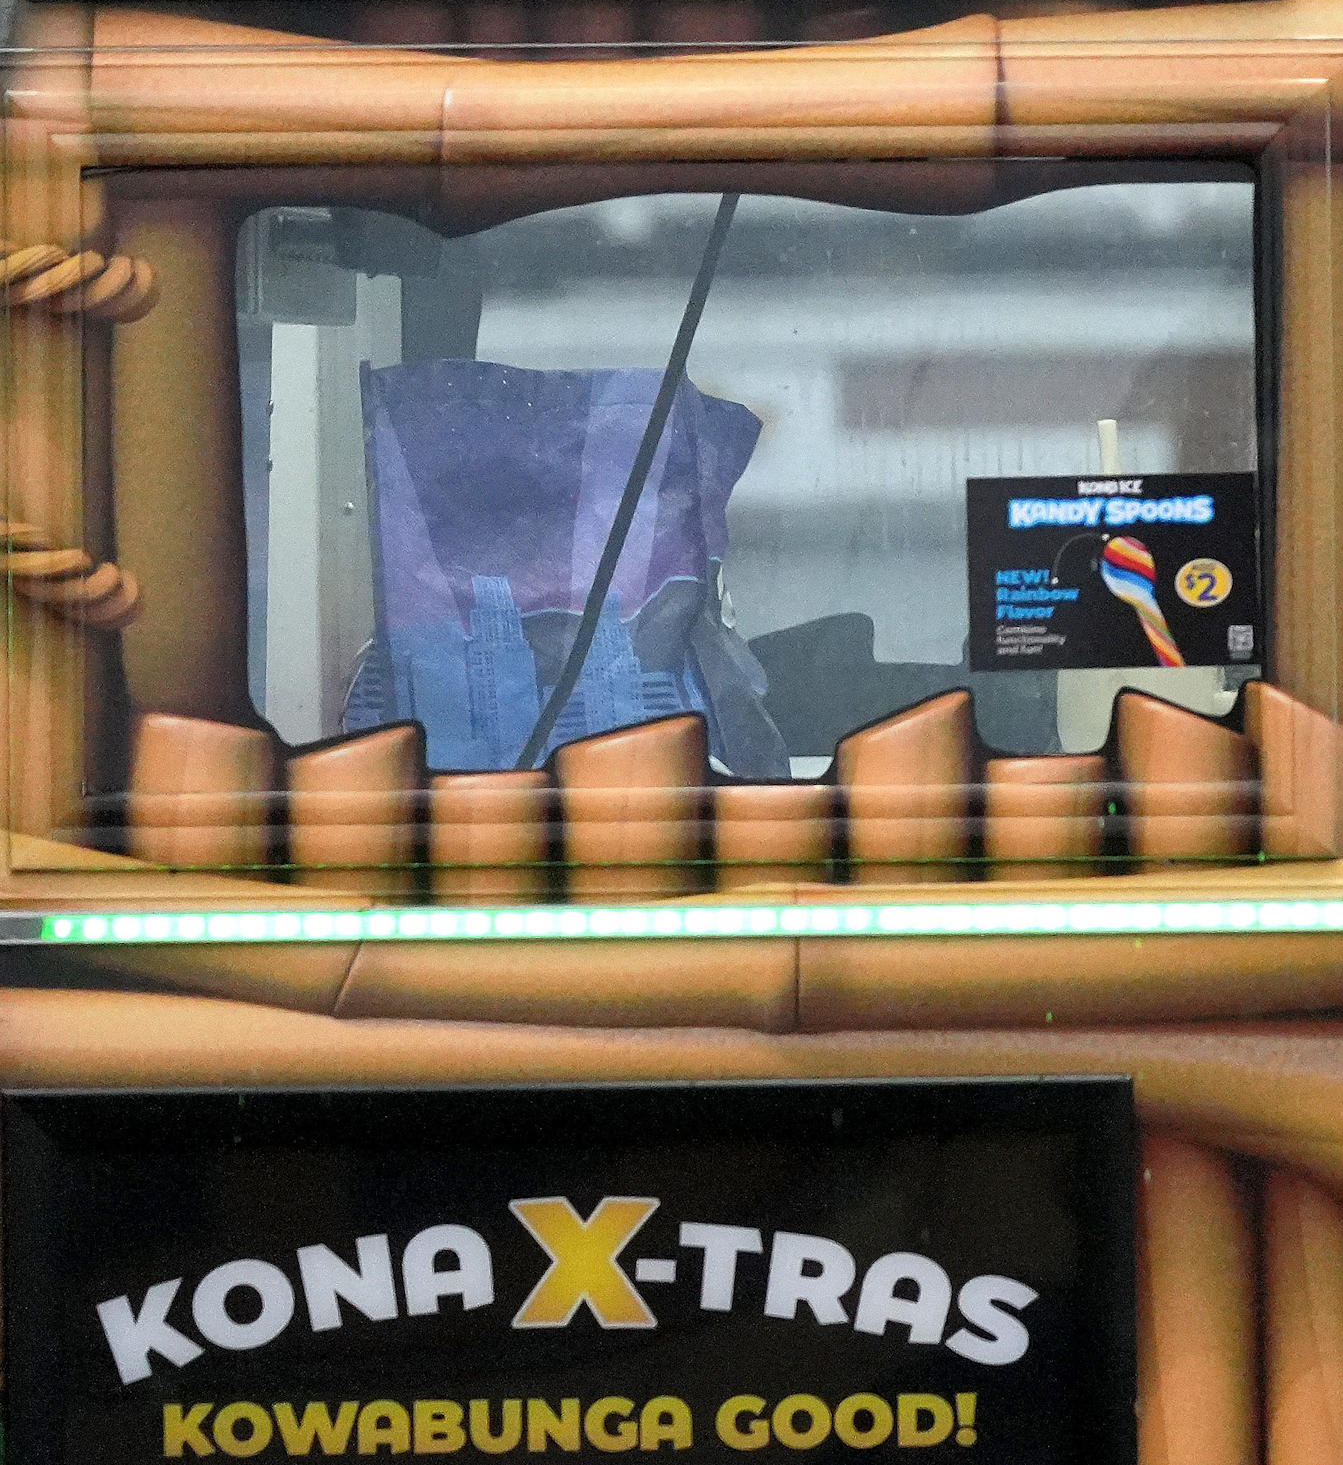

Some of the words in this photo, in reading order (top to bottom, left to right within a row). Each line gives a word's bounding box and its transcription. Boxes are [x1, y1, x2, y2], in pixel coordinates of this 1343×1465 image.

[1010, 499, 1104, 527] KANDY
[1105, 496, 1214, 525] SPOONS
[996, 586, 1080, 603] Rainbow
[1185, 572, 1218, 602] $2
[996, 604, 1055, 620] Flavor
[95, 1223, 494, 1386] KONA
[508, 1195, 1040, 1368] X-TRAS
[162, 1396, 691, 1458] KOWABUNGA
[716, 1392, 977, 1450] GOOD!
